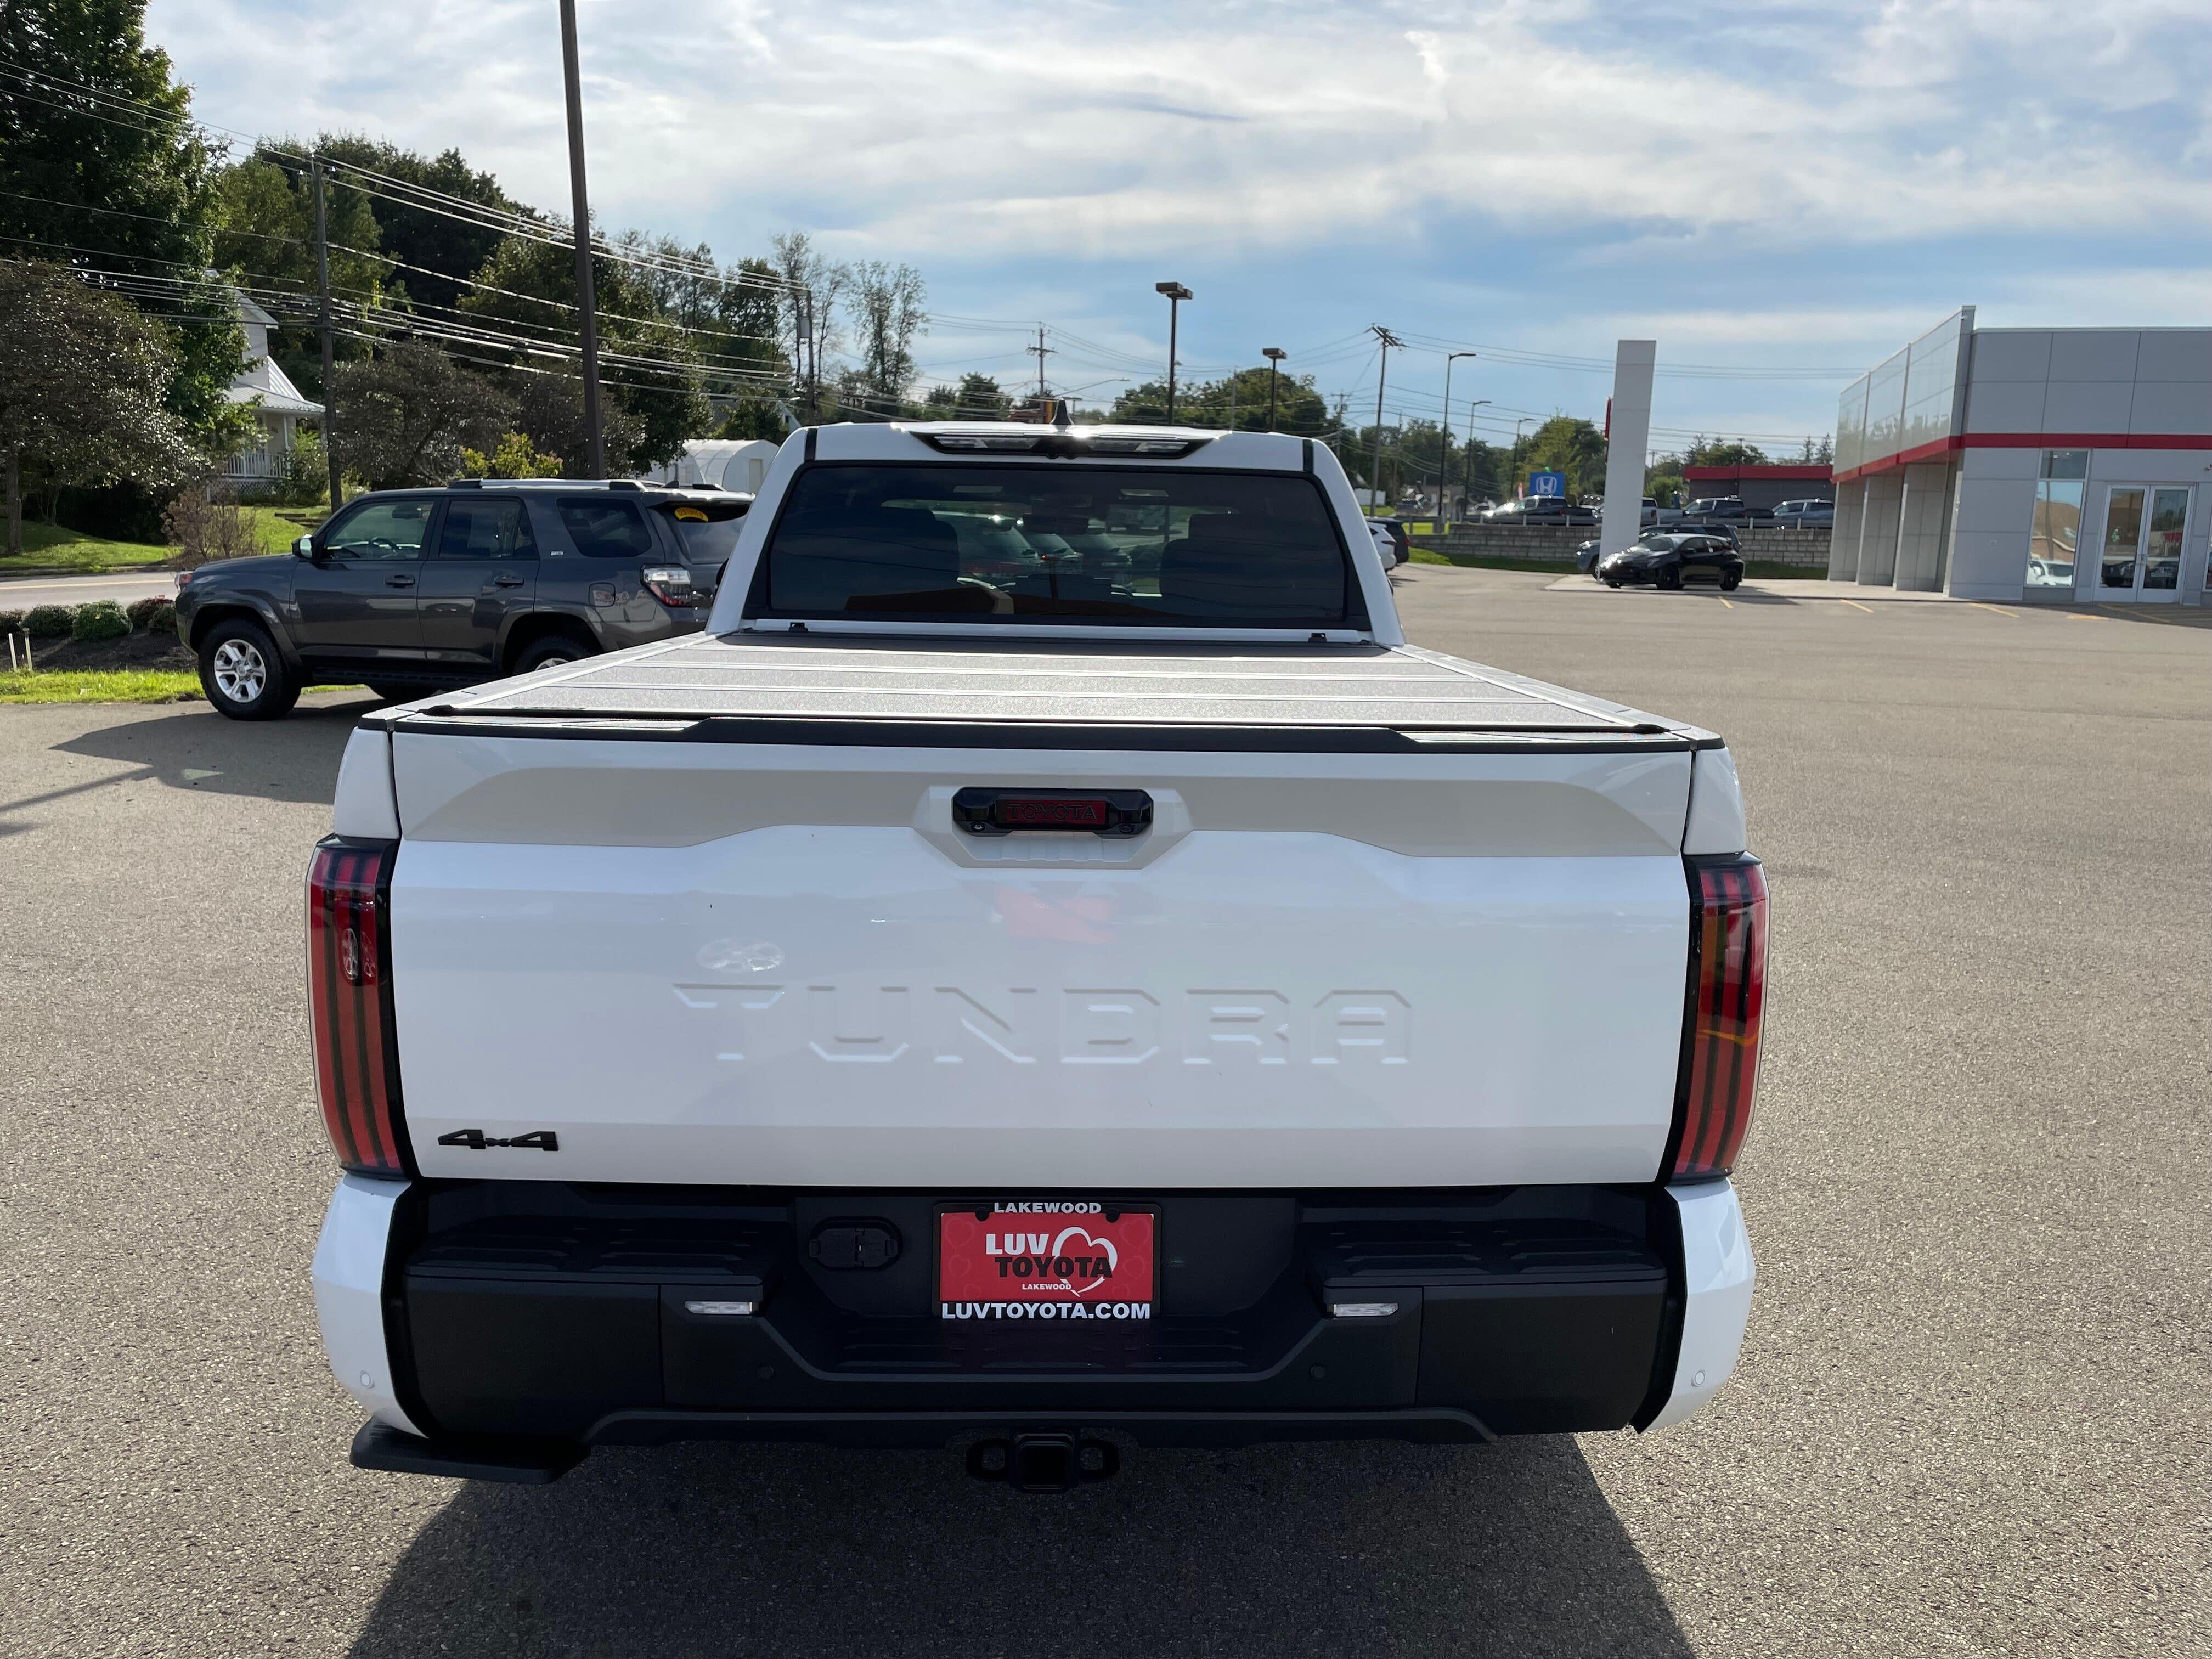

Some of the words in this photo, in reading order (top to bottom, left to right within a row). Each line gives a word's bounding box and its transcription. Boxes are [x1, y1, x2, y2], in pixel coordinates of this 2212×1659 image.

[1007, 803, 1098, 821] TOYOTA
[673, 984, 1413, 1066] TUNDRA
[994, 1201, 1102, 1214] LAKEWOOD
[986, 1233, 1049, 1255] LUV
[995, 1256, 1113, 1278] TOYOTA
[941, 1302, 1150, 1319] LUVTOYOTA.COM
